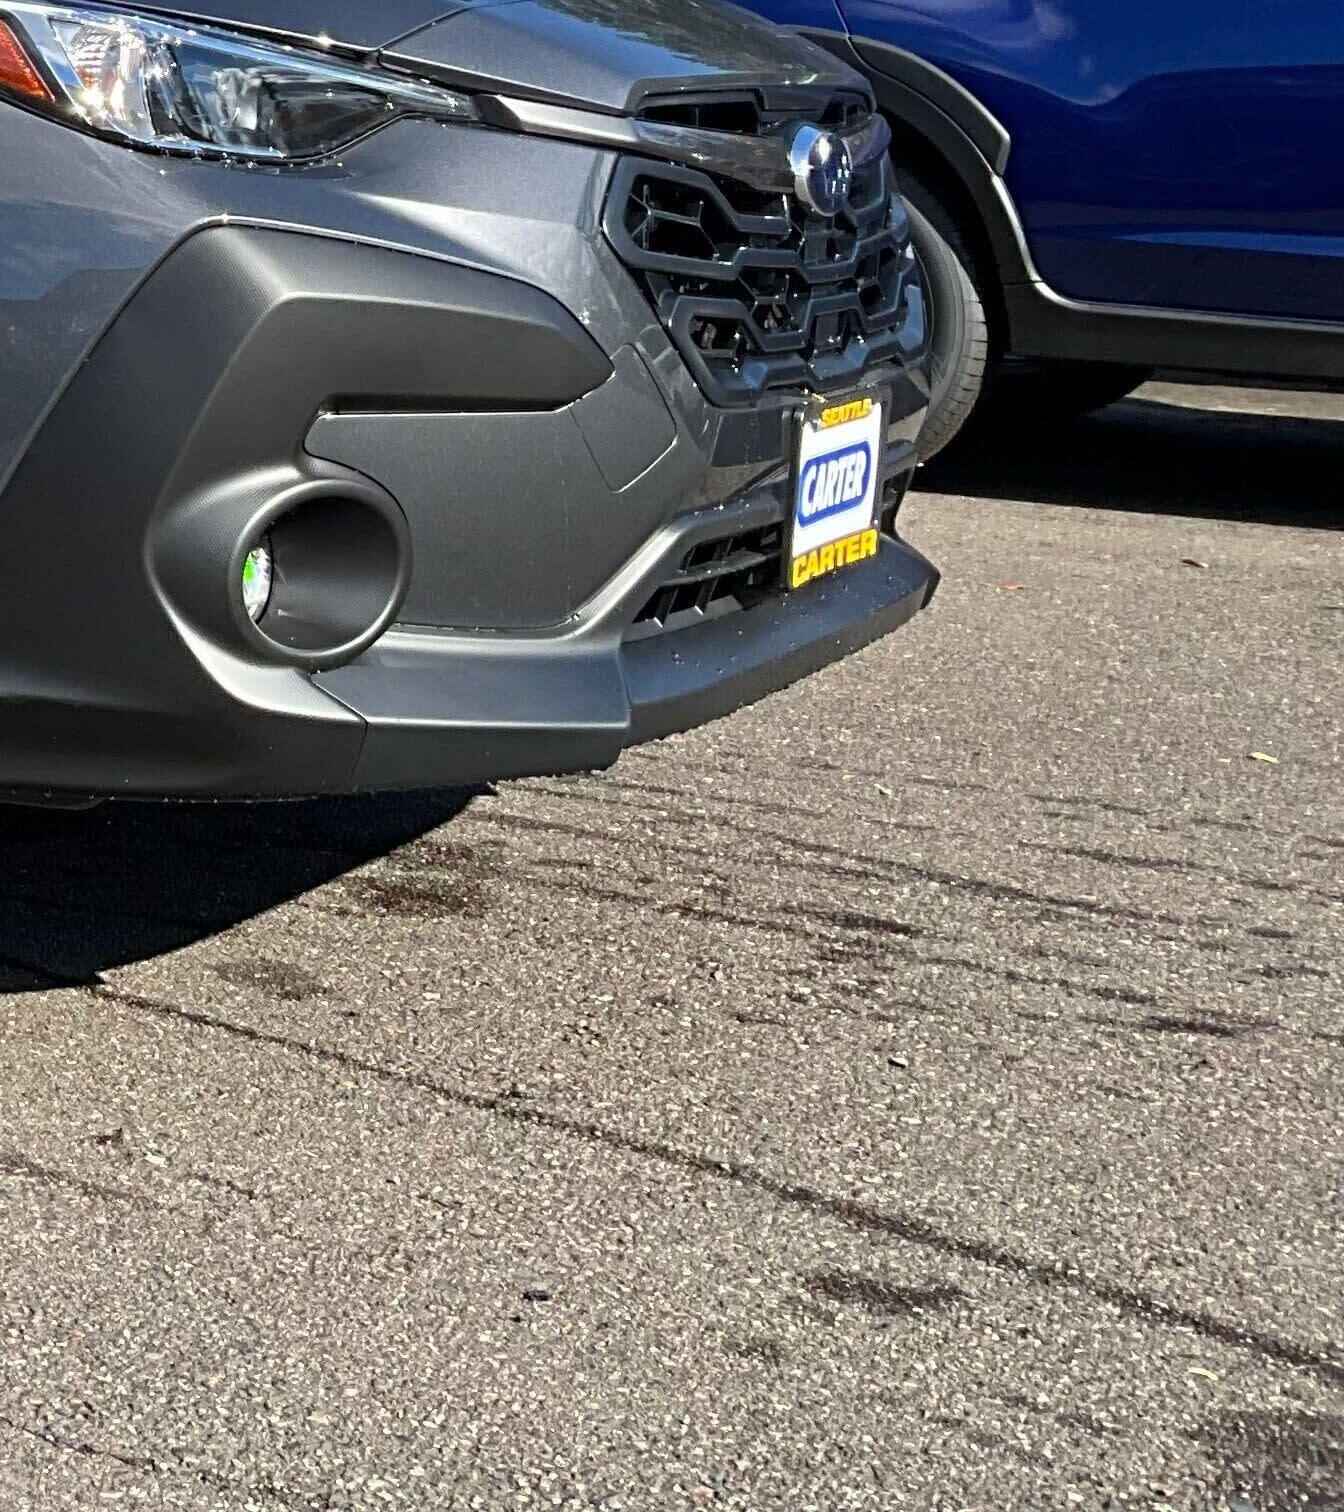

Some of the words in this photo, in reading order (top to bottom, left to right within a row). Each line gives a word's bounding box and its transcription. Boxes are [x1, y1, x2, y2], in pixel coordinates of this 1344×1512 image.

[821, 398, 873, 428] SEATTLE
[801, 450, 867, 518] CARTER
[792, 529, 878, 589] CARTER
